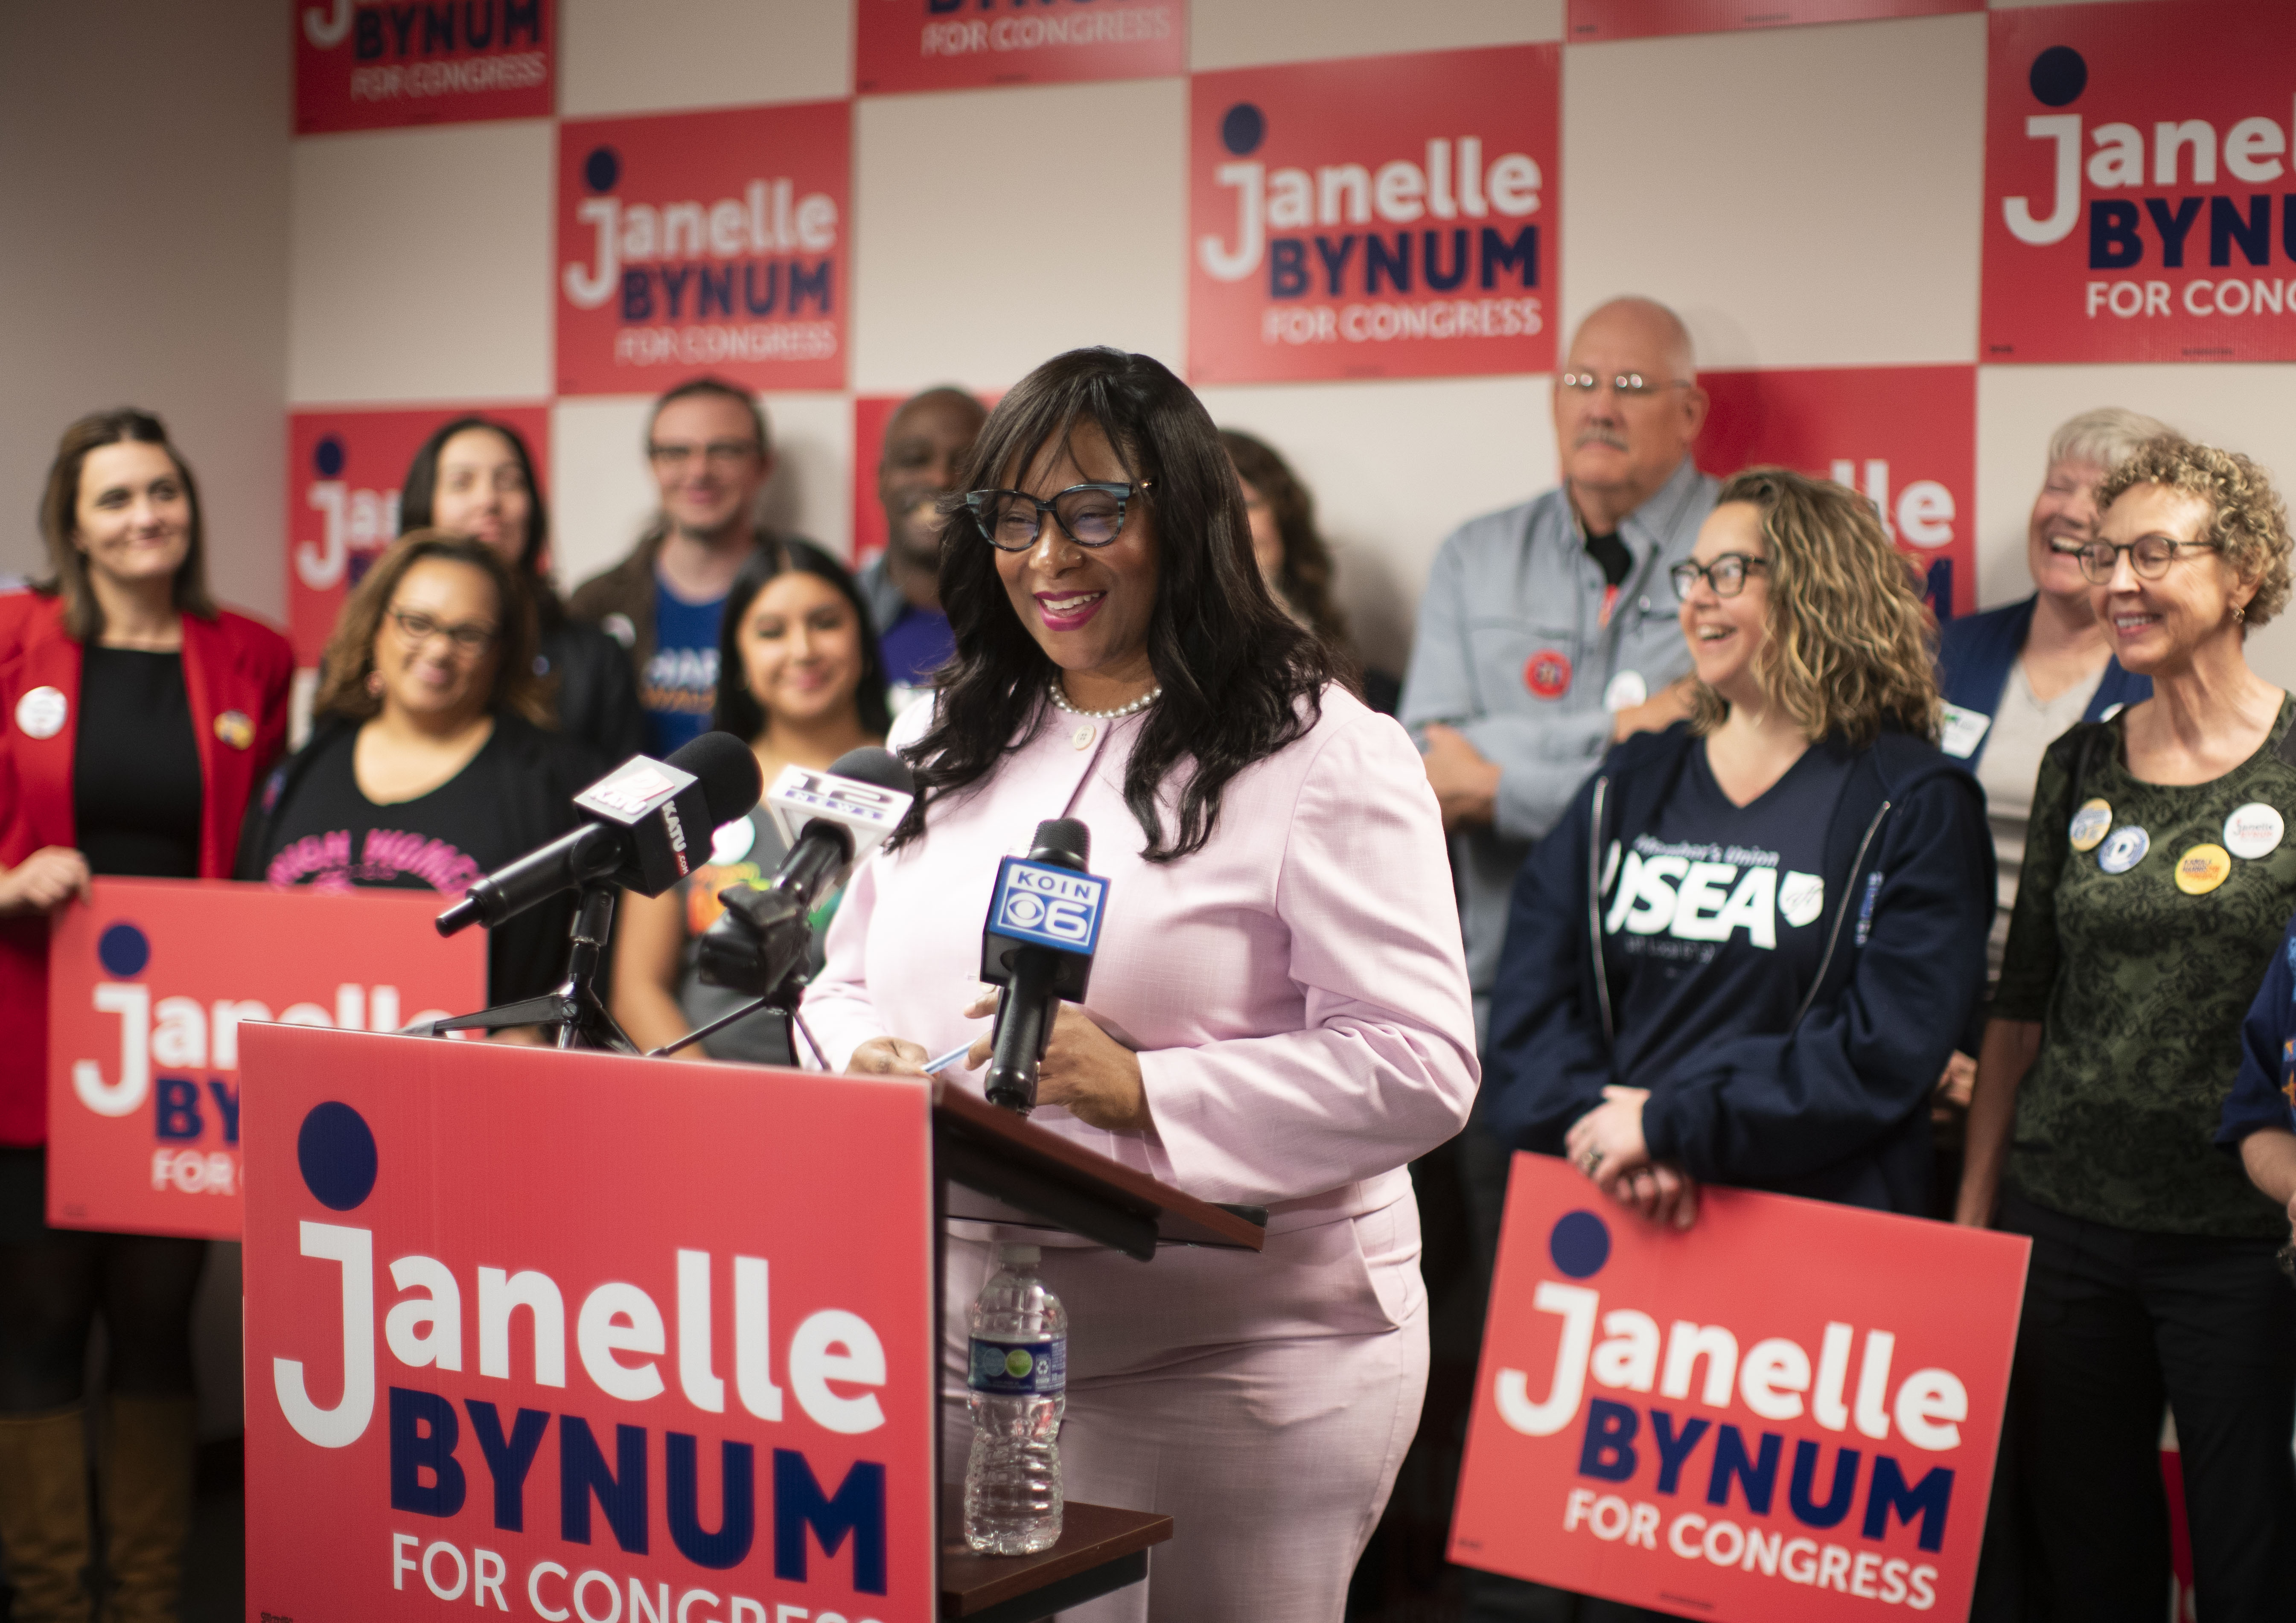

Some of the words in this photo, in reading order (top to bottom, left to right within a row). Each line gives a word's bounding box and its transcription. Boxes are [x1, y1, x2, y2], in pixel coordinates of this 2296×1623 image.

[921, 21, 987, 56] FOR
[989, 6, 1170, 51] CONGRESS
[2088, 193, 2296, 270] BYN
[1269, 225, 1541, 299] BYNUM
[620, 259, 833, 323] BYNUM
[2086, 279, 2172, 318] FOR
[616, 329, 679, 367] FOR
[683, 322, 838, 364] CONGRESS
[1263, 305, 1337, 345] FOR
[1341, 299, 1543, 343] CONGRESS
[790, 772, 894, 813] 12
[1017, 871, 1091, 899] KOIN
[1046, 900, 1087, 939] 6
[152, 1150, 236, 1195] FOR
[389, 1385, 888, 1597] BYNUM
[1576, 1396, 1956, 1553] BYNUM
[393, 1532, 510, 1612] FOR
[1563, 1488, 1661, 1550] FOR
[1668, 1513, 1938, 1610] CONGRESS
